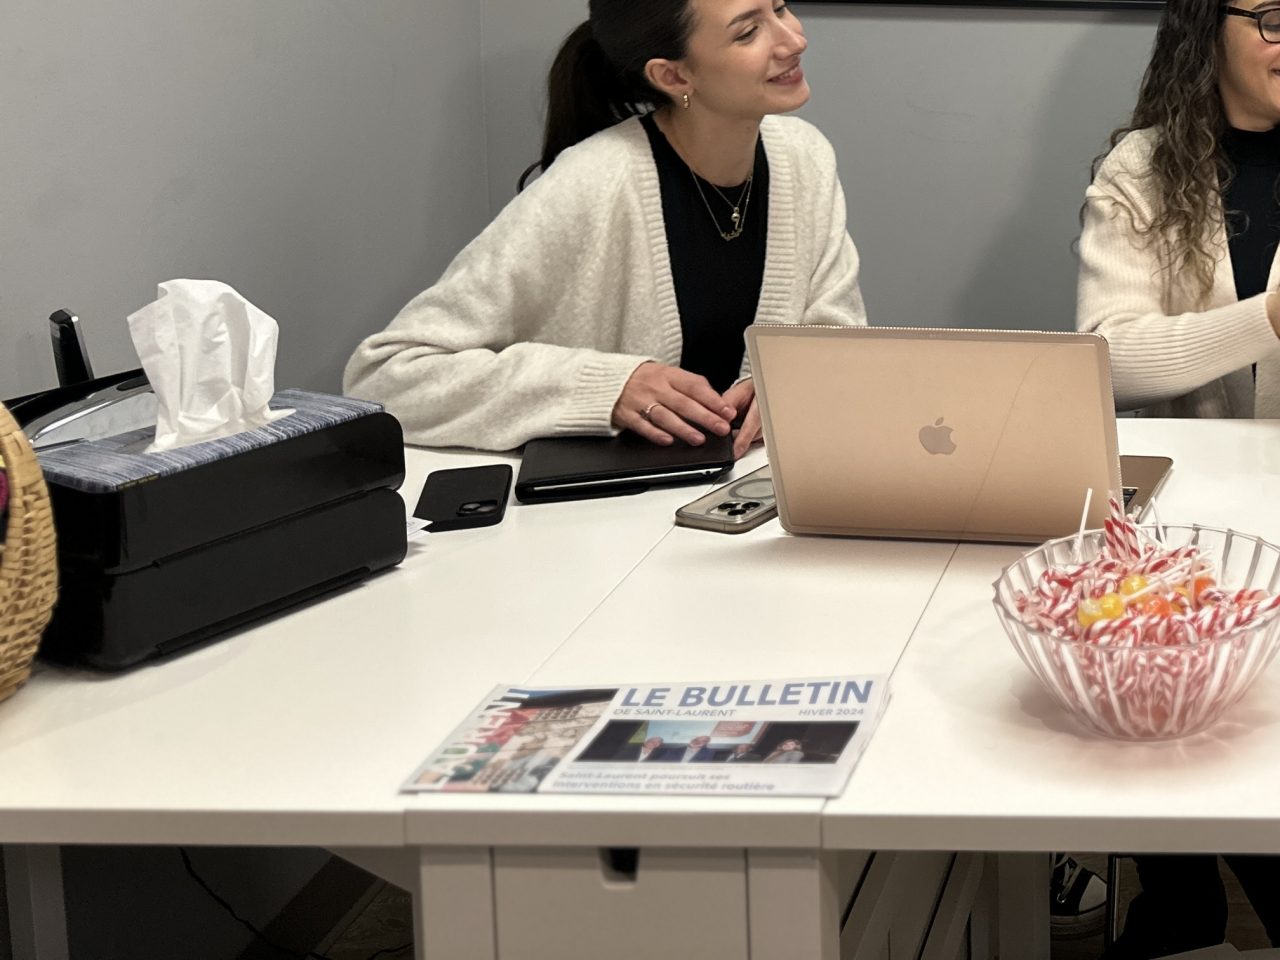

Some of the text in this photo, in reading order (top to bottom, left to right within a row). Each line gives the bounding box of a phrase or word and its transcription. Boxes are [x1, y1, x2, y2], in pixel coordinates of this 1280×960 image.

[620, 680, 874, 707] LE BULLETIN
[613, 708, 632, 716] DE
[634, 708, 737, 717] SAINT-LAURENT
